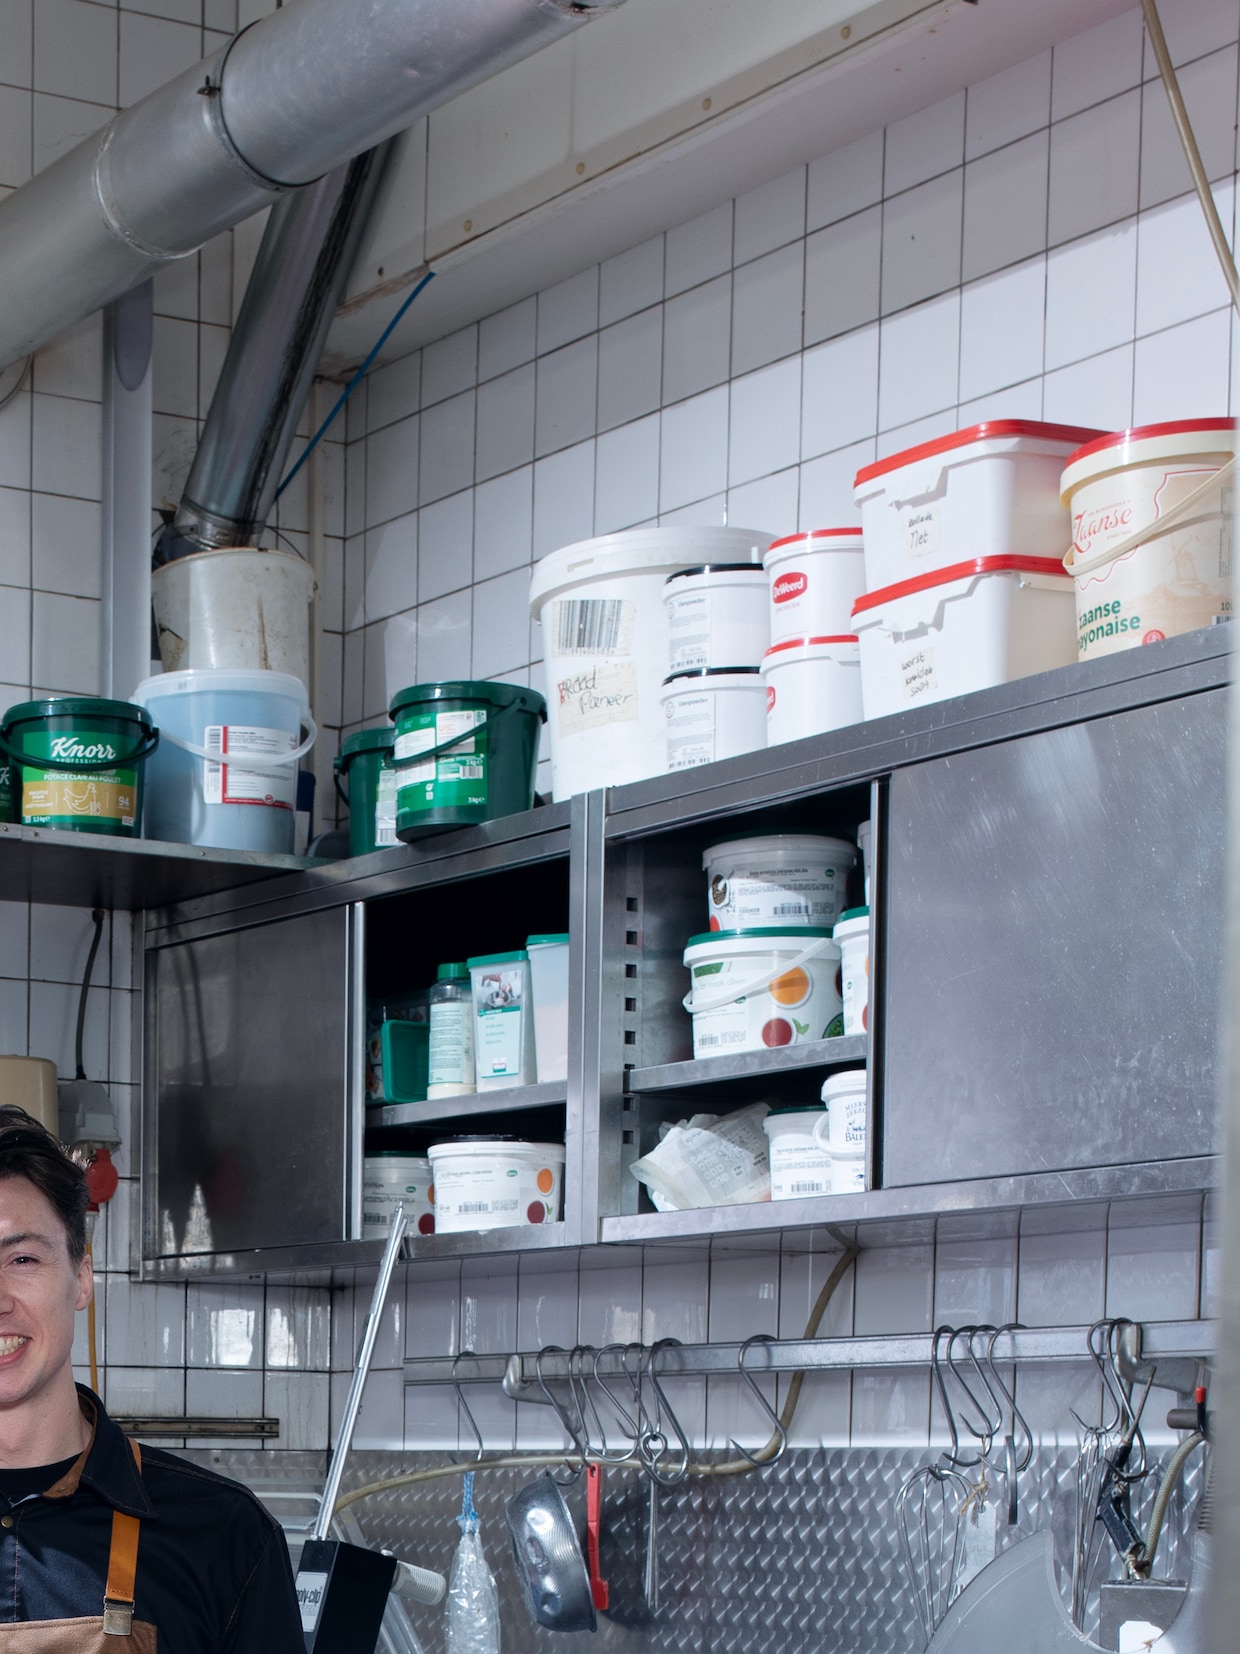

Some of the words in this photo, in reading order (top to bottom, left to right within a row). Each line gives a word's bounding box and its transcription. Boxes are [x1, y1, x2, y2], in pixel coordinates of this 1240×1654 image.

[1073, 509, 1132, 553] Zaanse
[50, 737, 116, 759] Knorr
[845, 1133, 865, 1142] BALE
